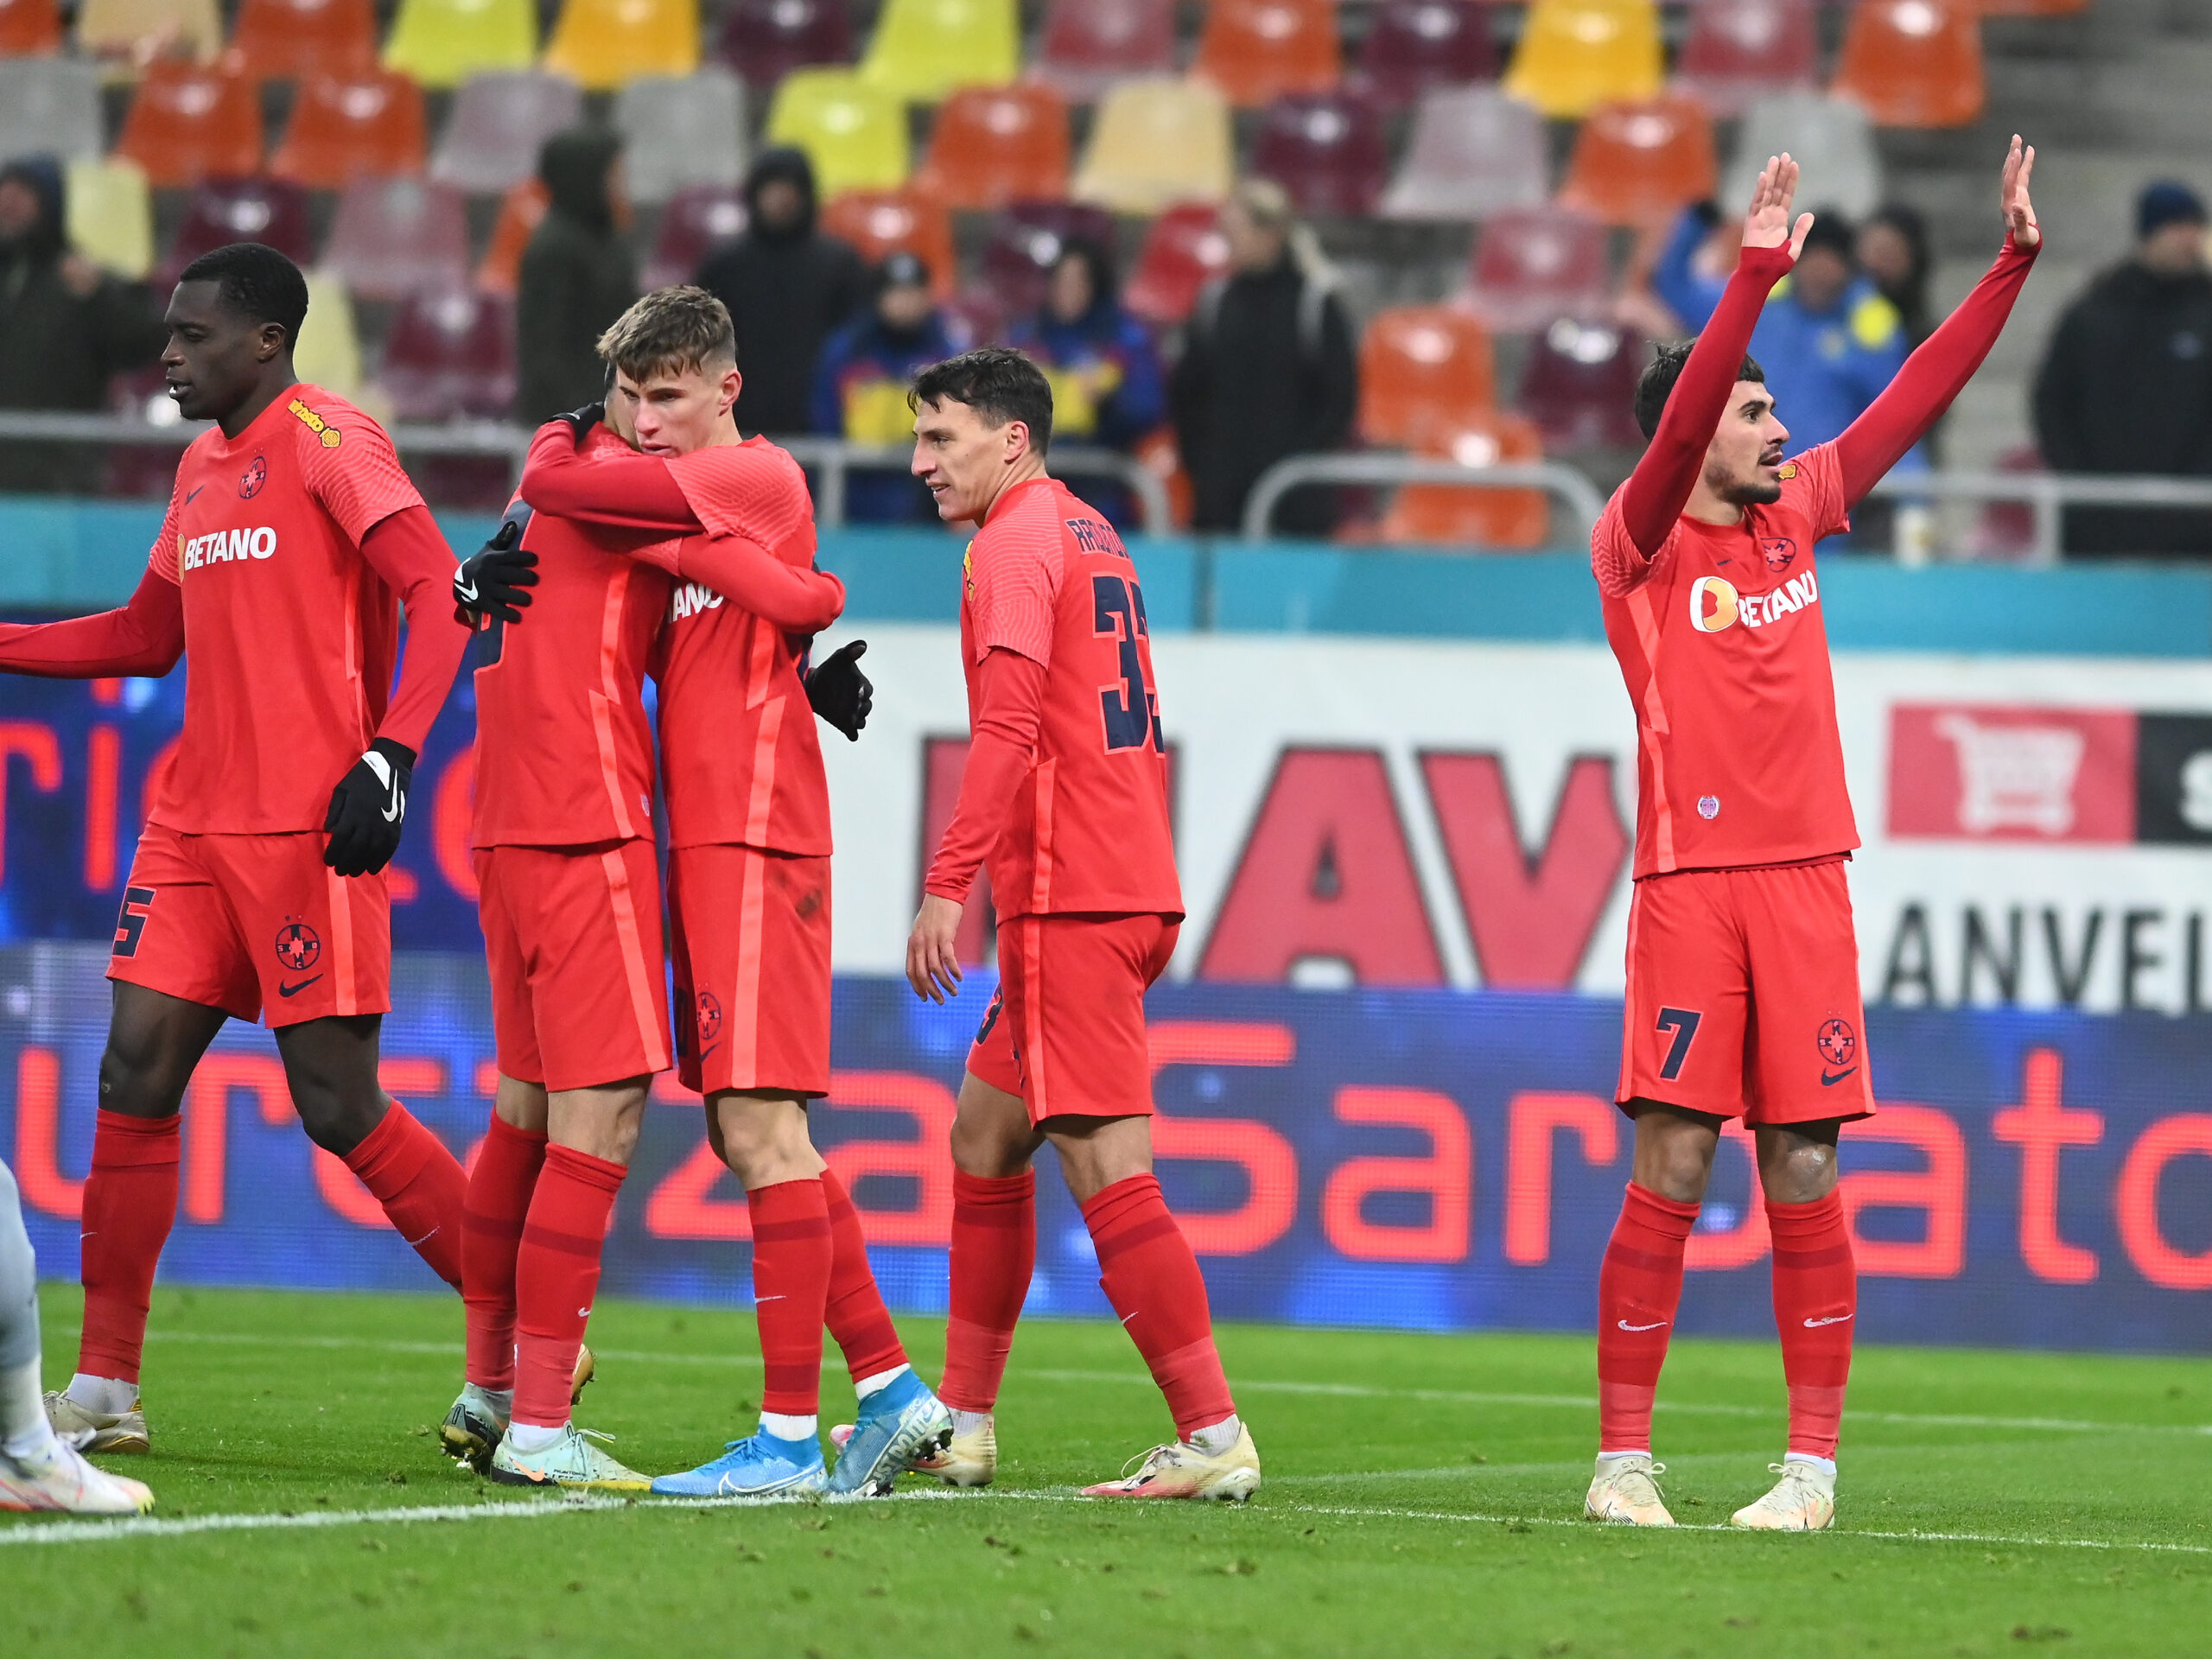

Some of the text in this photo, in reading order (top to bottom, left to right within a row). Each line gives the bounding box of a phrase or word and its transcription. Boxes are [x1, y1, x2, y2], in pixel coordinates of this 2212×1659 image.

[184, 526, 276, 571] BETANO
[672, 582, 724, 622] ANO
[1738, 569, 1818, 627] BETANO
[920, 734, 1631, 991] AV
[1656, 1006, 1703, 1081] 7
